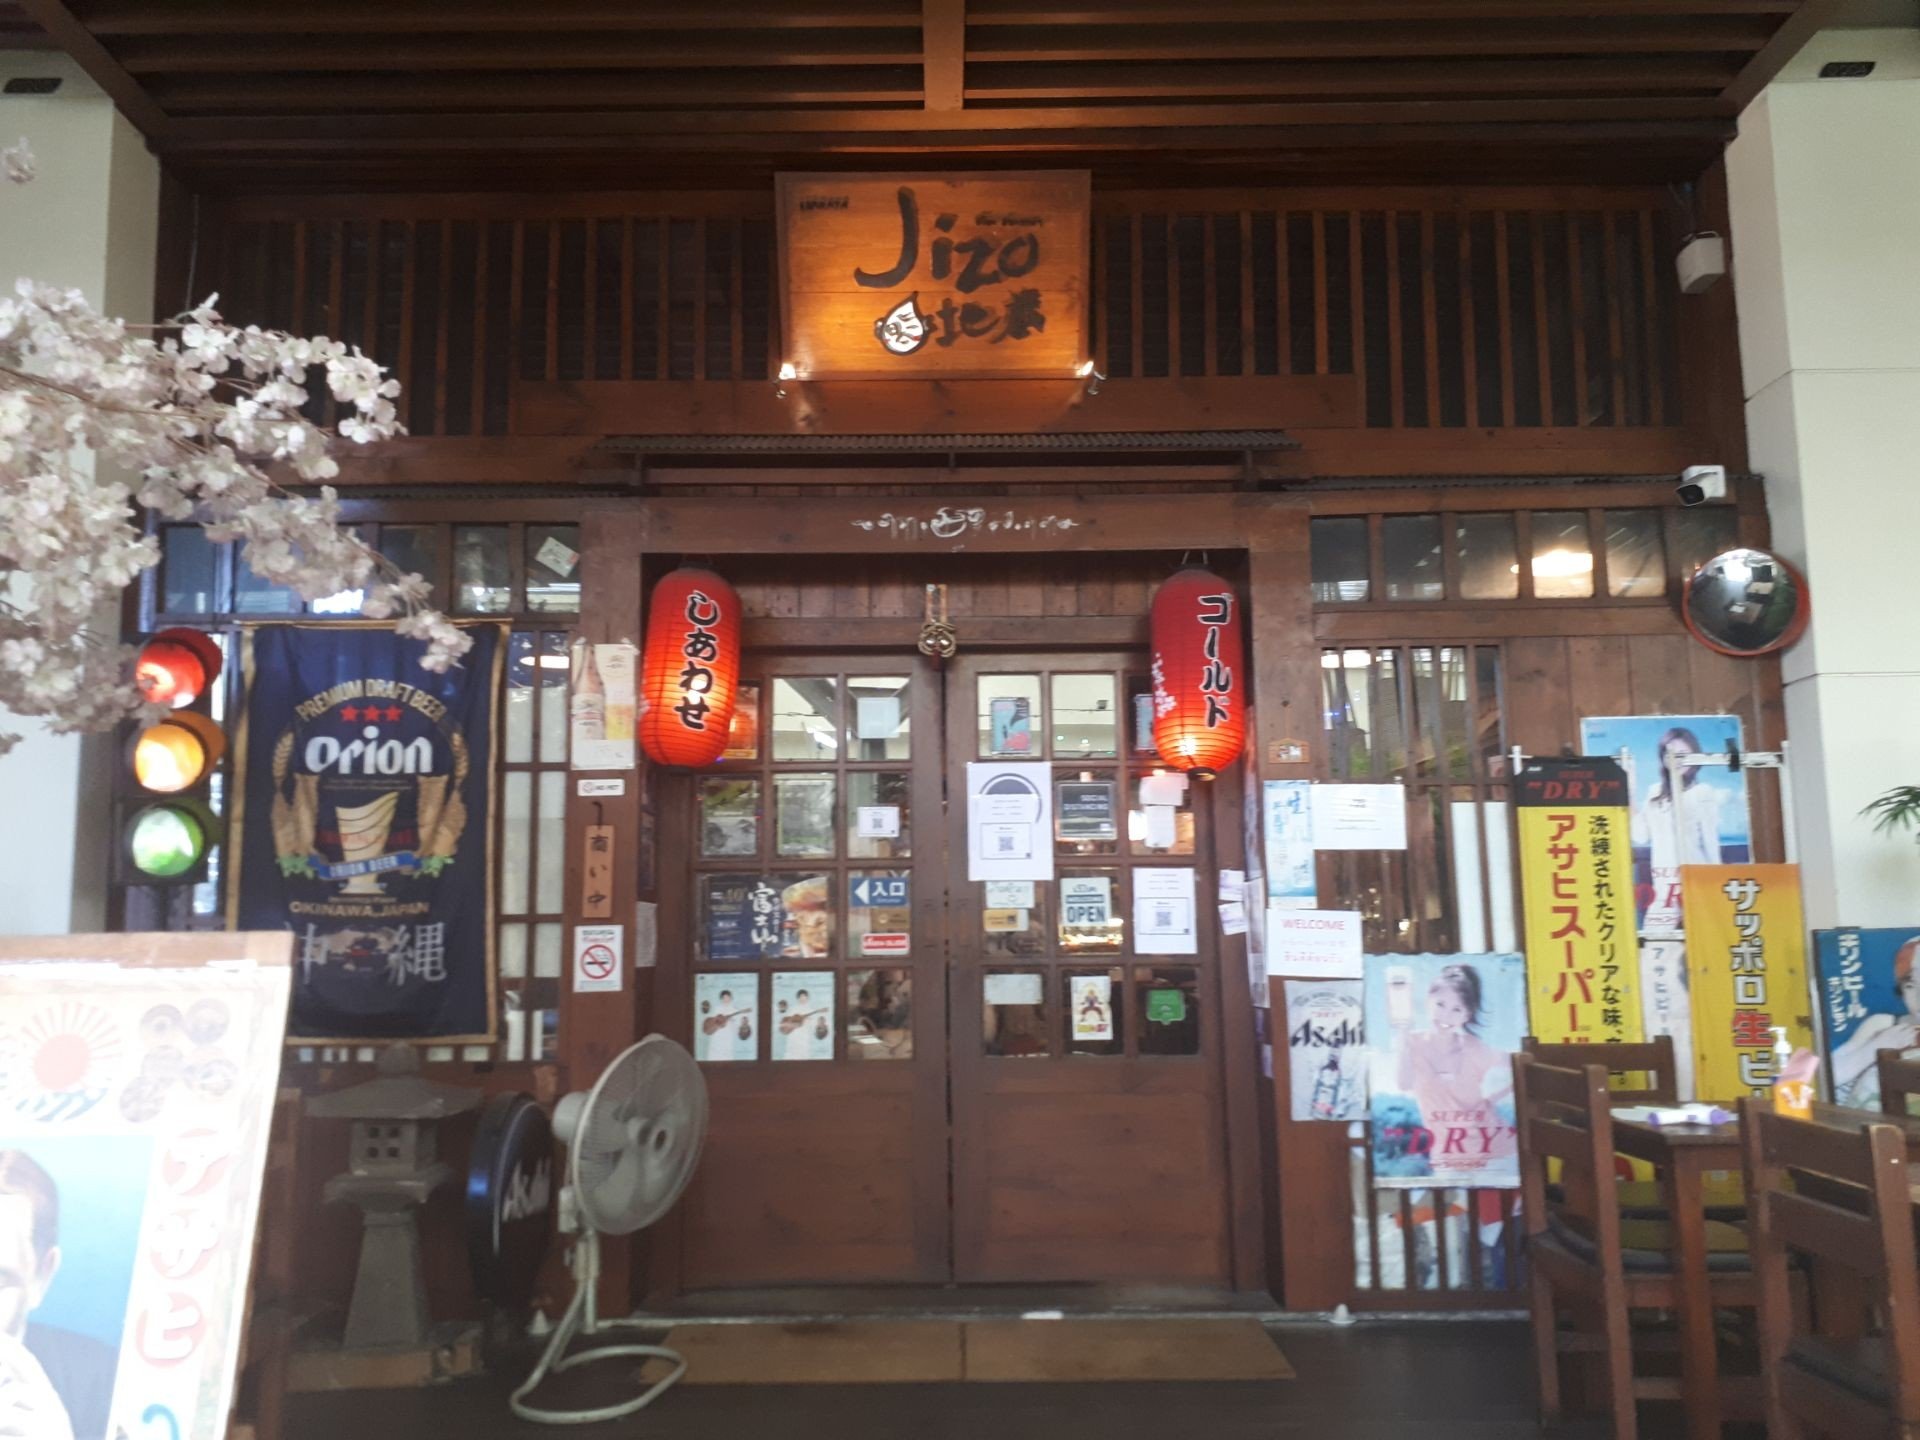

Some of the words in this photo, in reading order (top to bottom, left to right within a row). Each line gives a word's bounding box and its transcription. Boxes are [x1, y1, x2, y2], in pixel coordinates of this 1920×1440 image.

[853, 186, 1039, 293] Jizo
[673, 590, 722, 732] しあわせ
[1197, 591, 1233, 730] ゴールド
[295, 679, 363, 722] PREMIUM
[364, 678, 415, 703] DRAFT
[748, 881, 779, 945] 富士山
[871, 881, 905, 897] 入口
[1067, 906, 1105, 922] OPEN
[1280, 919, 1345, 930] WELCOME
[1546, 815, 1594, 1044] アサヒスーパー
[1722, 878, 1776, 1098] サッポロ生ビ
[1837, 932, 1868, 1019] キリンビール
[1290, 1019, 1366, 1049] Asahi
[1430, 1110, 1487, 1122] SUPER
